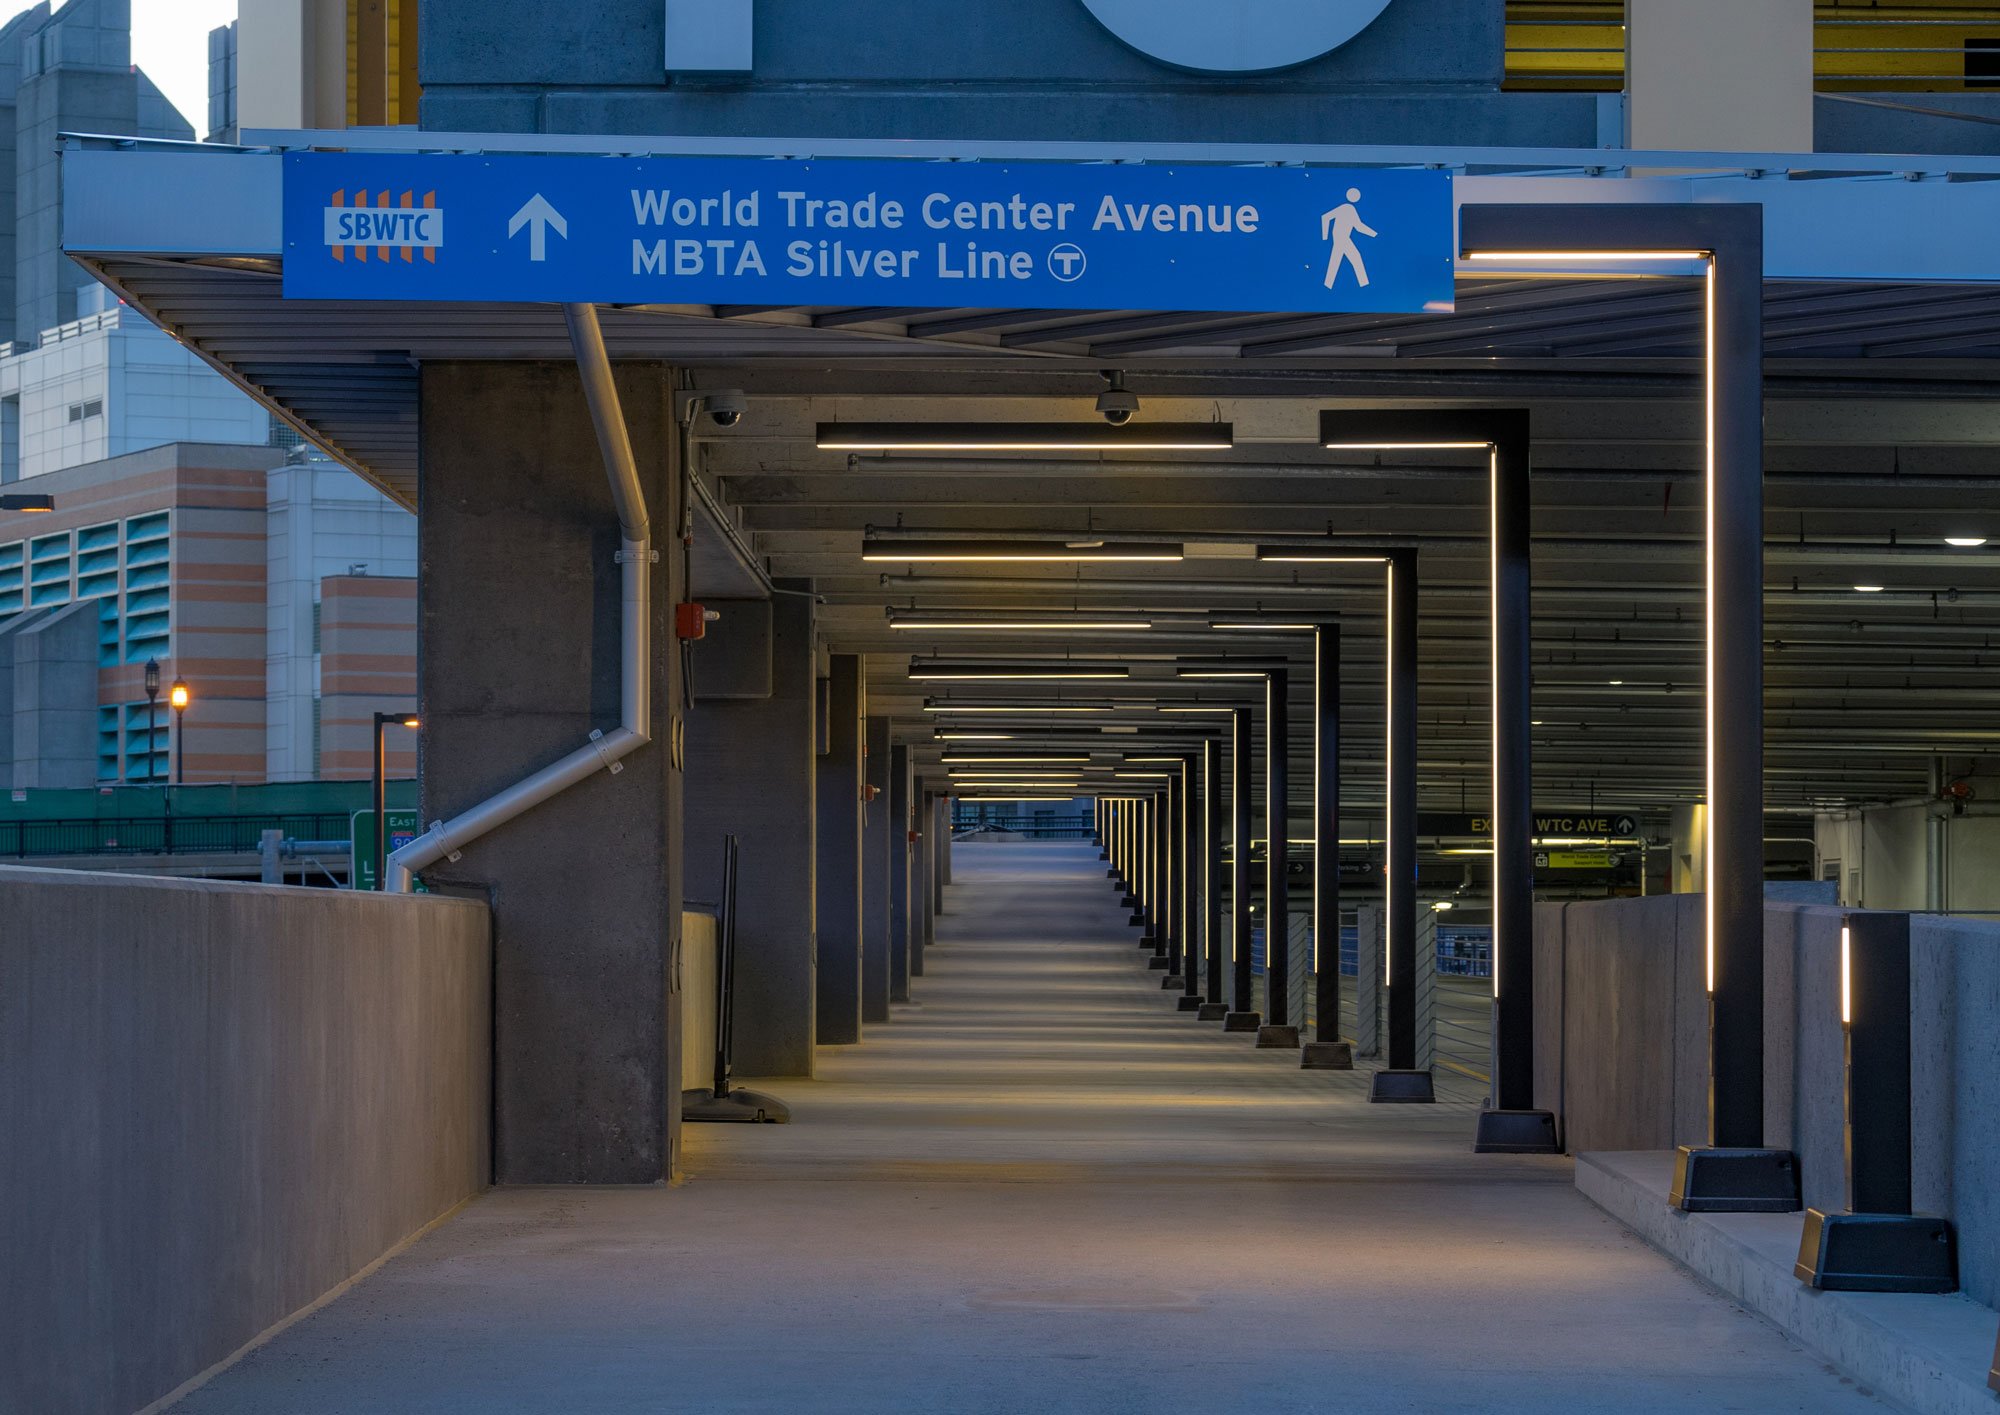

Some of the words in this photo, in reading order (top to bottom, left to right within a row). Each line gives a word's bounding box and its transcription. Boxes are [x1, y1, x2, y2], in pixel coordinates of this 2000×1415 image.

[338, 212, 430, 242] SBWTC
[631, 189, 759, 227] World
[778, 191, 904, 229] Trade
[922, 192, 1075, 231] Center
[1092, 195, 1259, 233] Avenue
[632, 239, 767, 276] MBTA
[786, 240, 919, 278] Silver
[938, 241, 1033, 280] Line
[1536, 819, 1572, 832] WTC
[1577, 819, 1612, 832] AVE.
